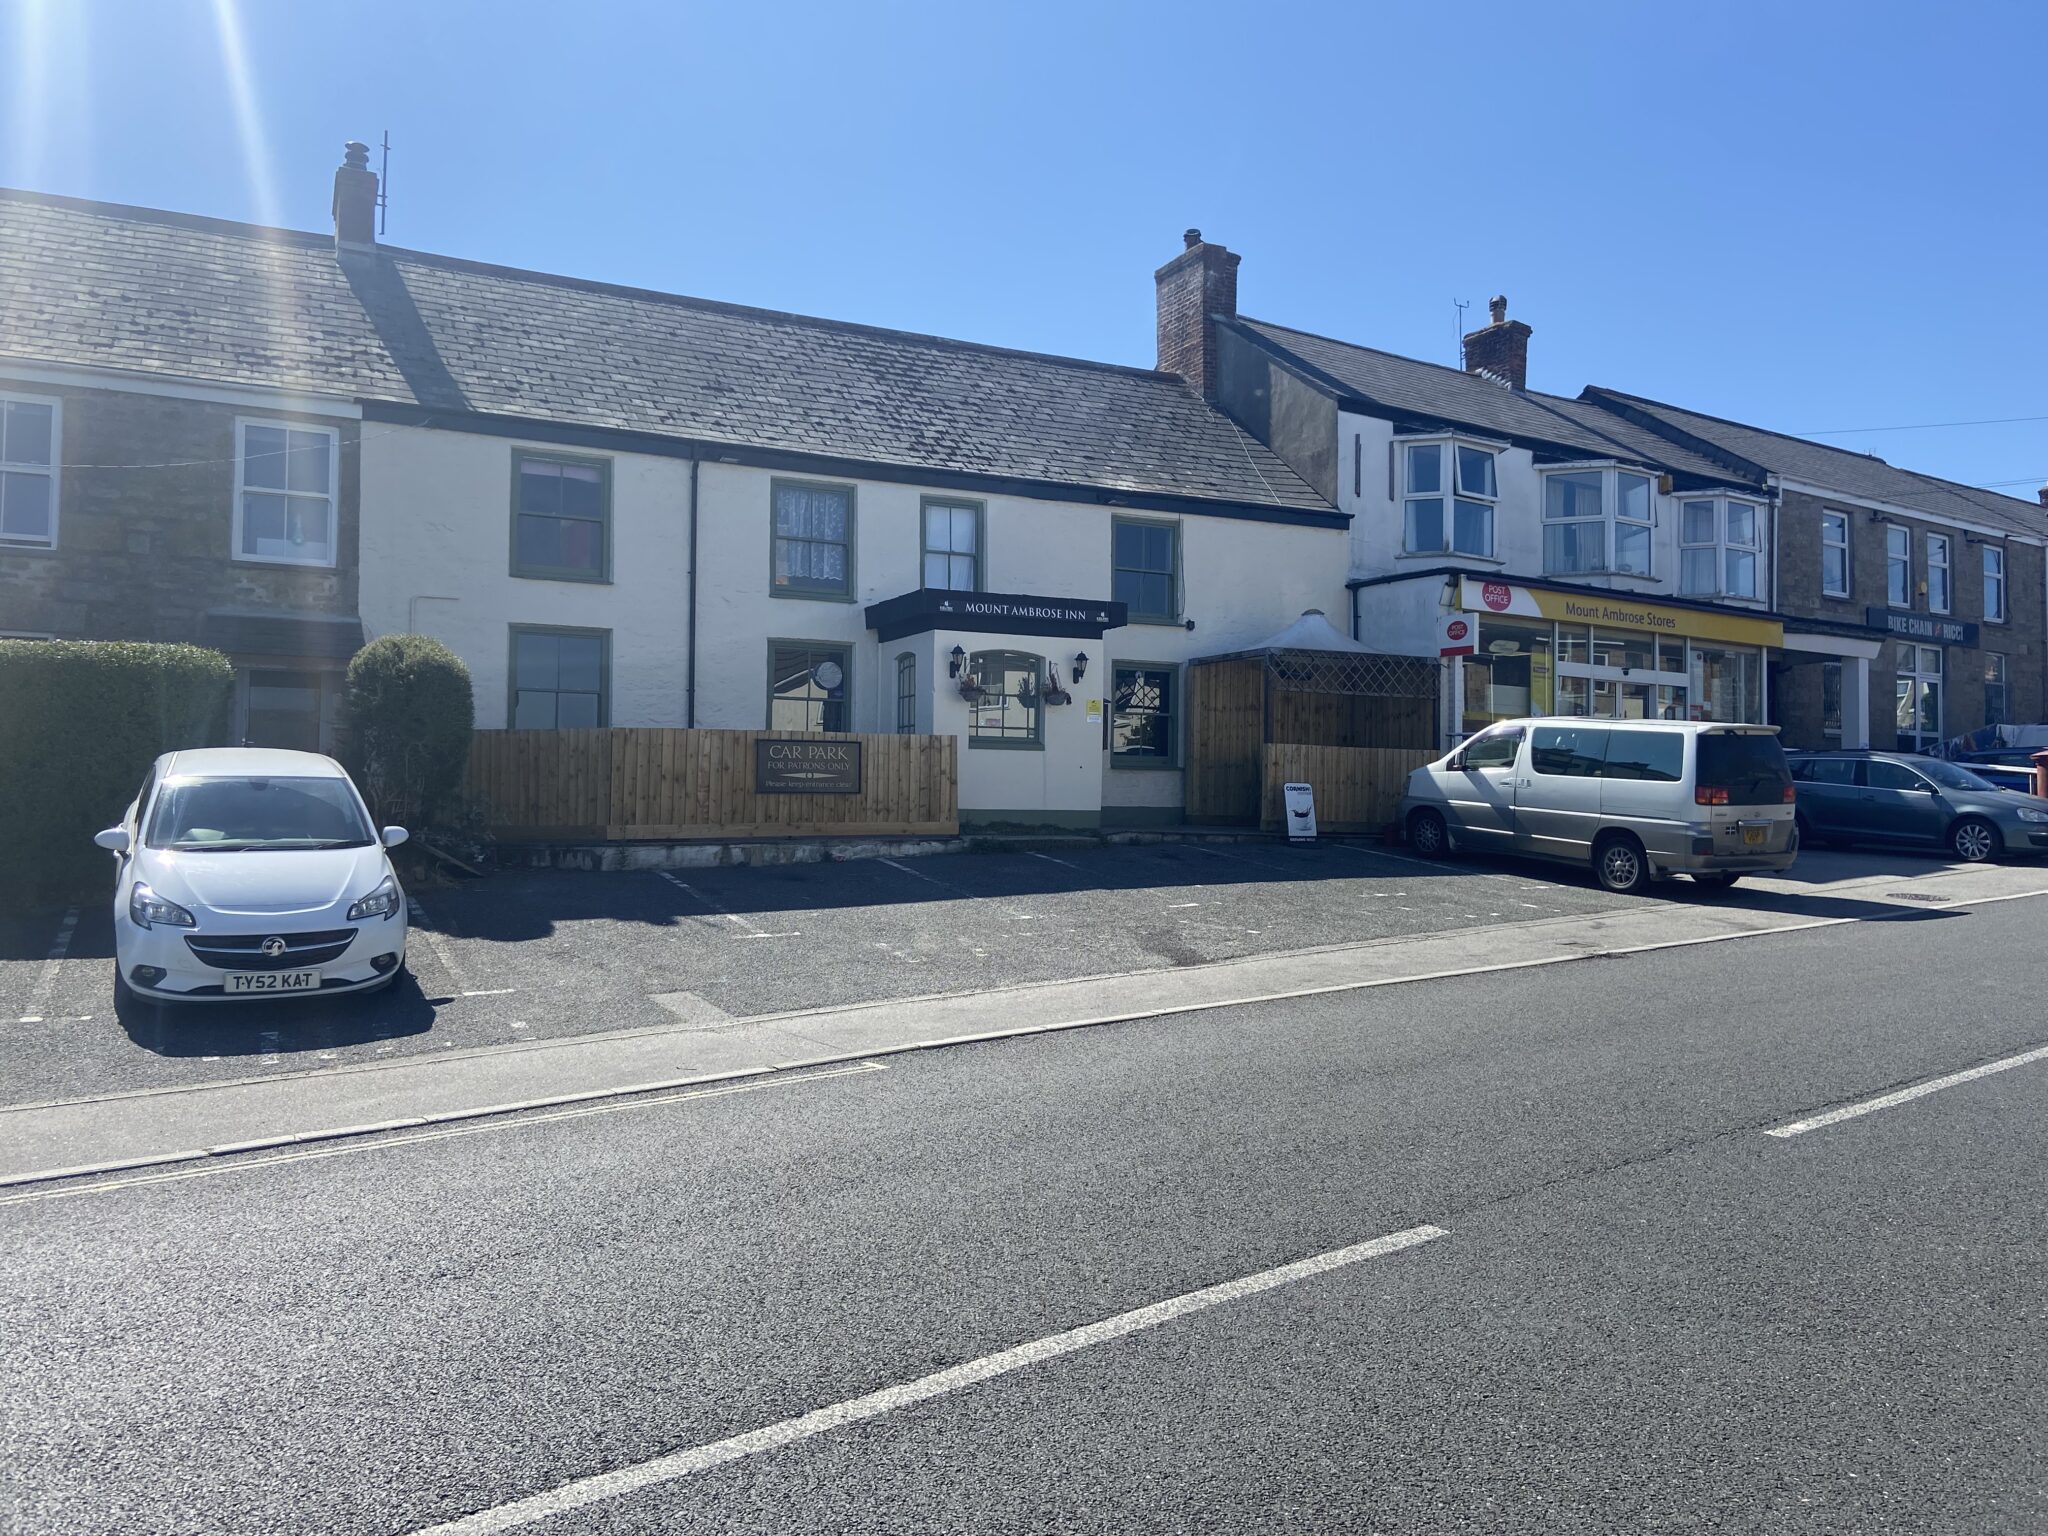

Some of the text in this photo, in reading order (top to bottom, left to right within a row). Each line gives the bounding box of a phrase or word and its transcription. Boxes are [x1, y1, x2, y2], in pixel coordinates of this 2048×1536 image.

[1488, 585, 1506, 595] POST
[1484, 593, 1508, 604] OFFICE
[965, 602, 1009, 615] MOUNT
[1011, 605, 1062, 619] AMBROSE
[1065, 609, 1086, 620] INN
[1565, 602, 1676, 629] Mount Ambrose Stores
[1888, 615, 1907, 633] BIKE
[1908, 618, 1932, 637] CHAIN
[769, 745, 848, 760] CAR PARK
[767, 761, 850, 771] FOR PATRONS ONLY
[233, 973, 312, 990] TY52 KAT
